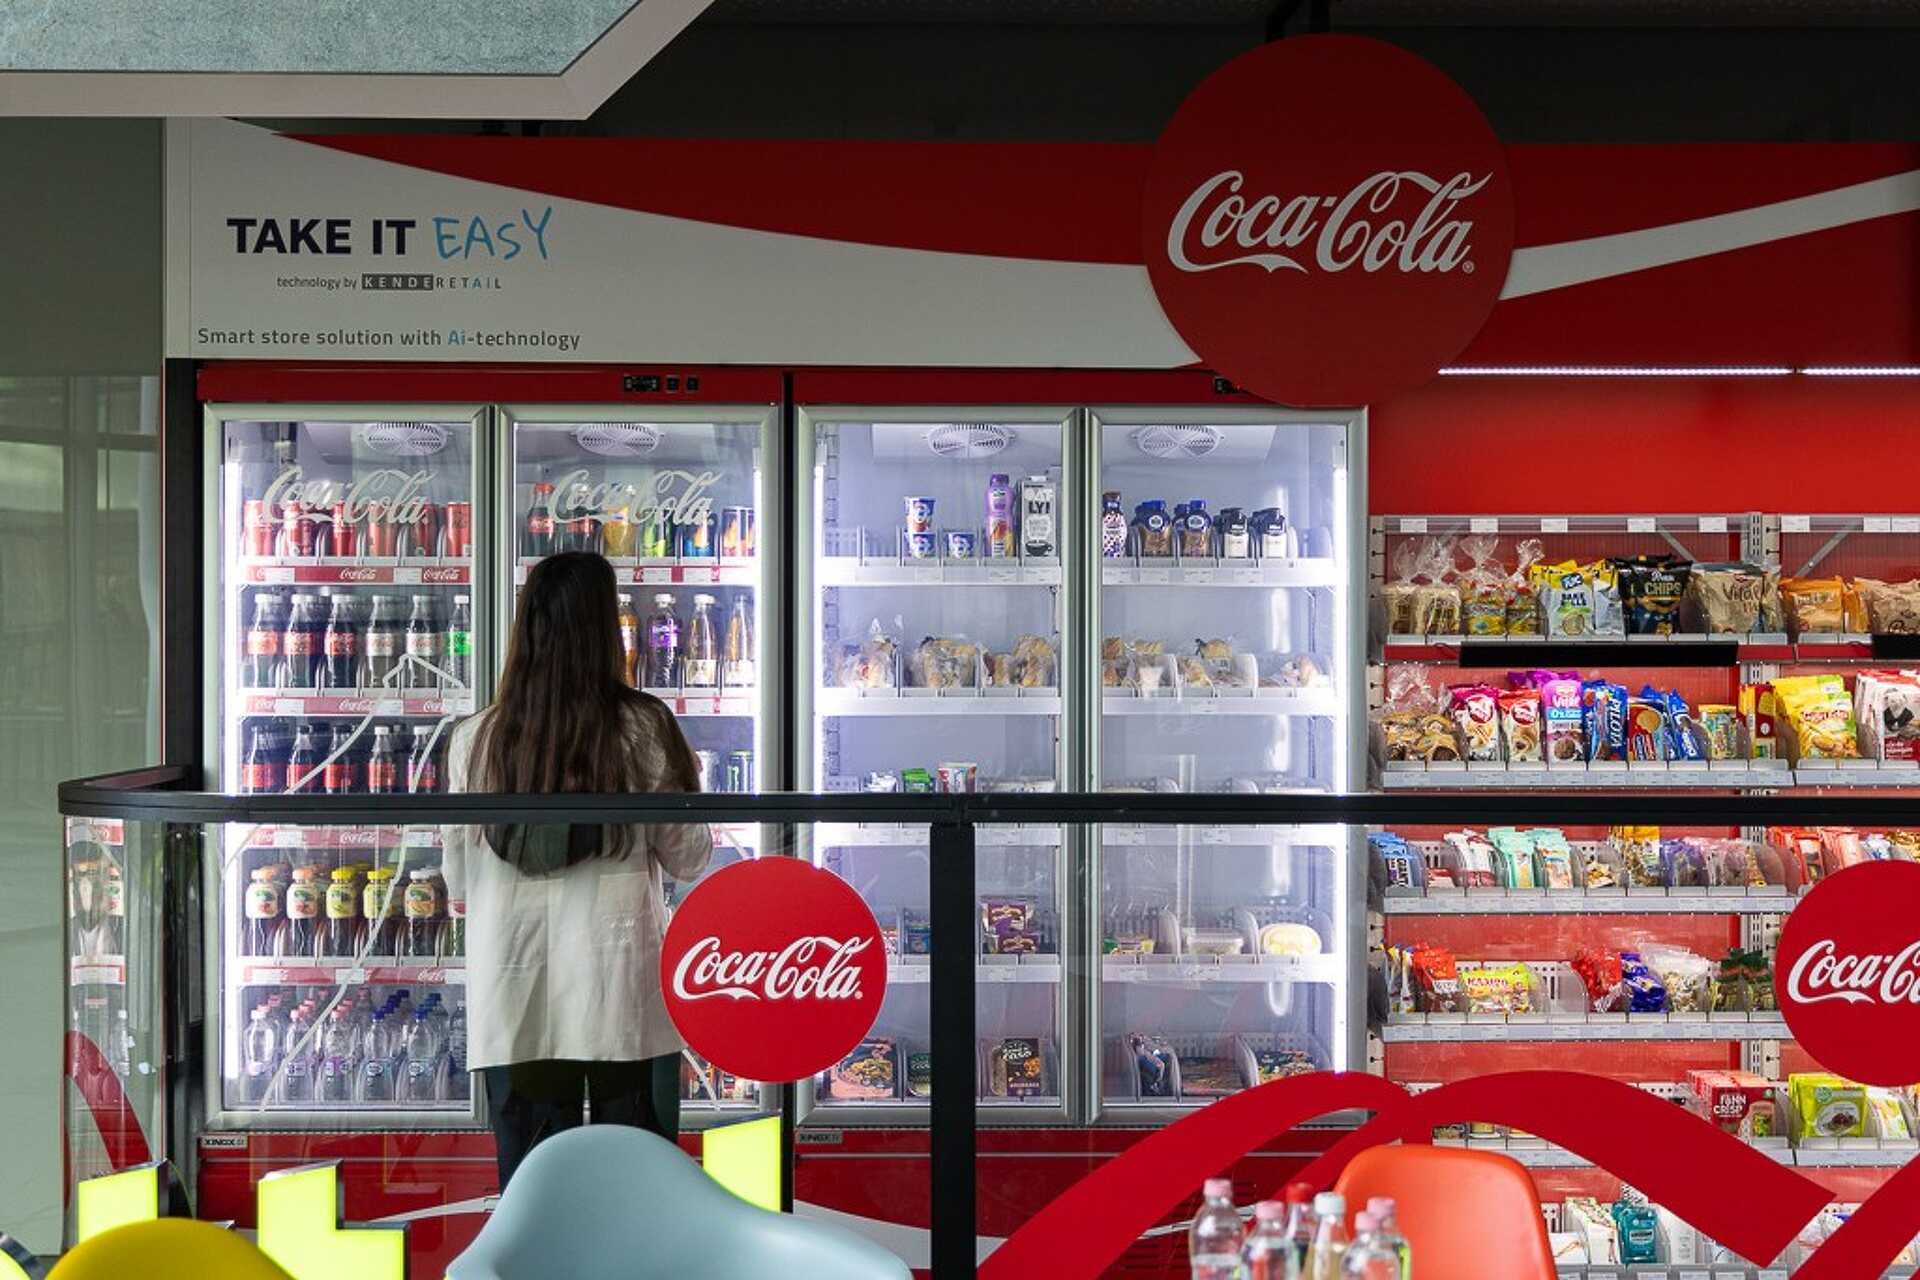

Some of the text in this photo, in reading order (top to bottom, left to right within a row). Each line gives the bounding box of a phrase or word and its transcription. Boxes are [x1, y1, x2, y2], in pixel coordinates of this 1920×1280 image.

[227, 206, 551, 260] TAKE IT EASY
[1168, 170, 1493, 274] Coca-Cola
[276, 277, 341, 291] technology
[344, 278, 357, 291] by
[197, 328, 580, 352] Smart store solution with Ai-technology
[263, 466, 438, 525] Coca-Cola
[548, 469, 725, 526] Coca-Cola
[1645, 582, 1682, 595] CHIPS
[673, 936, 875, 1000] Coca-Cola
